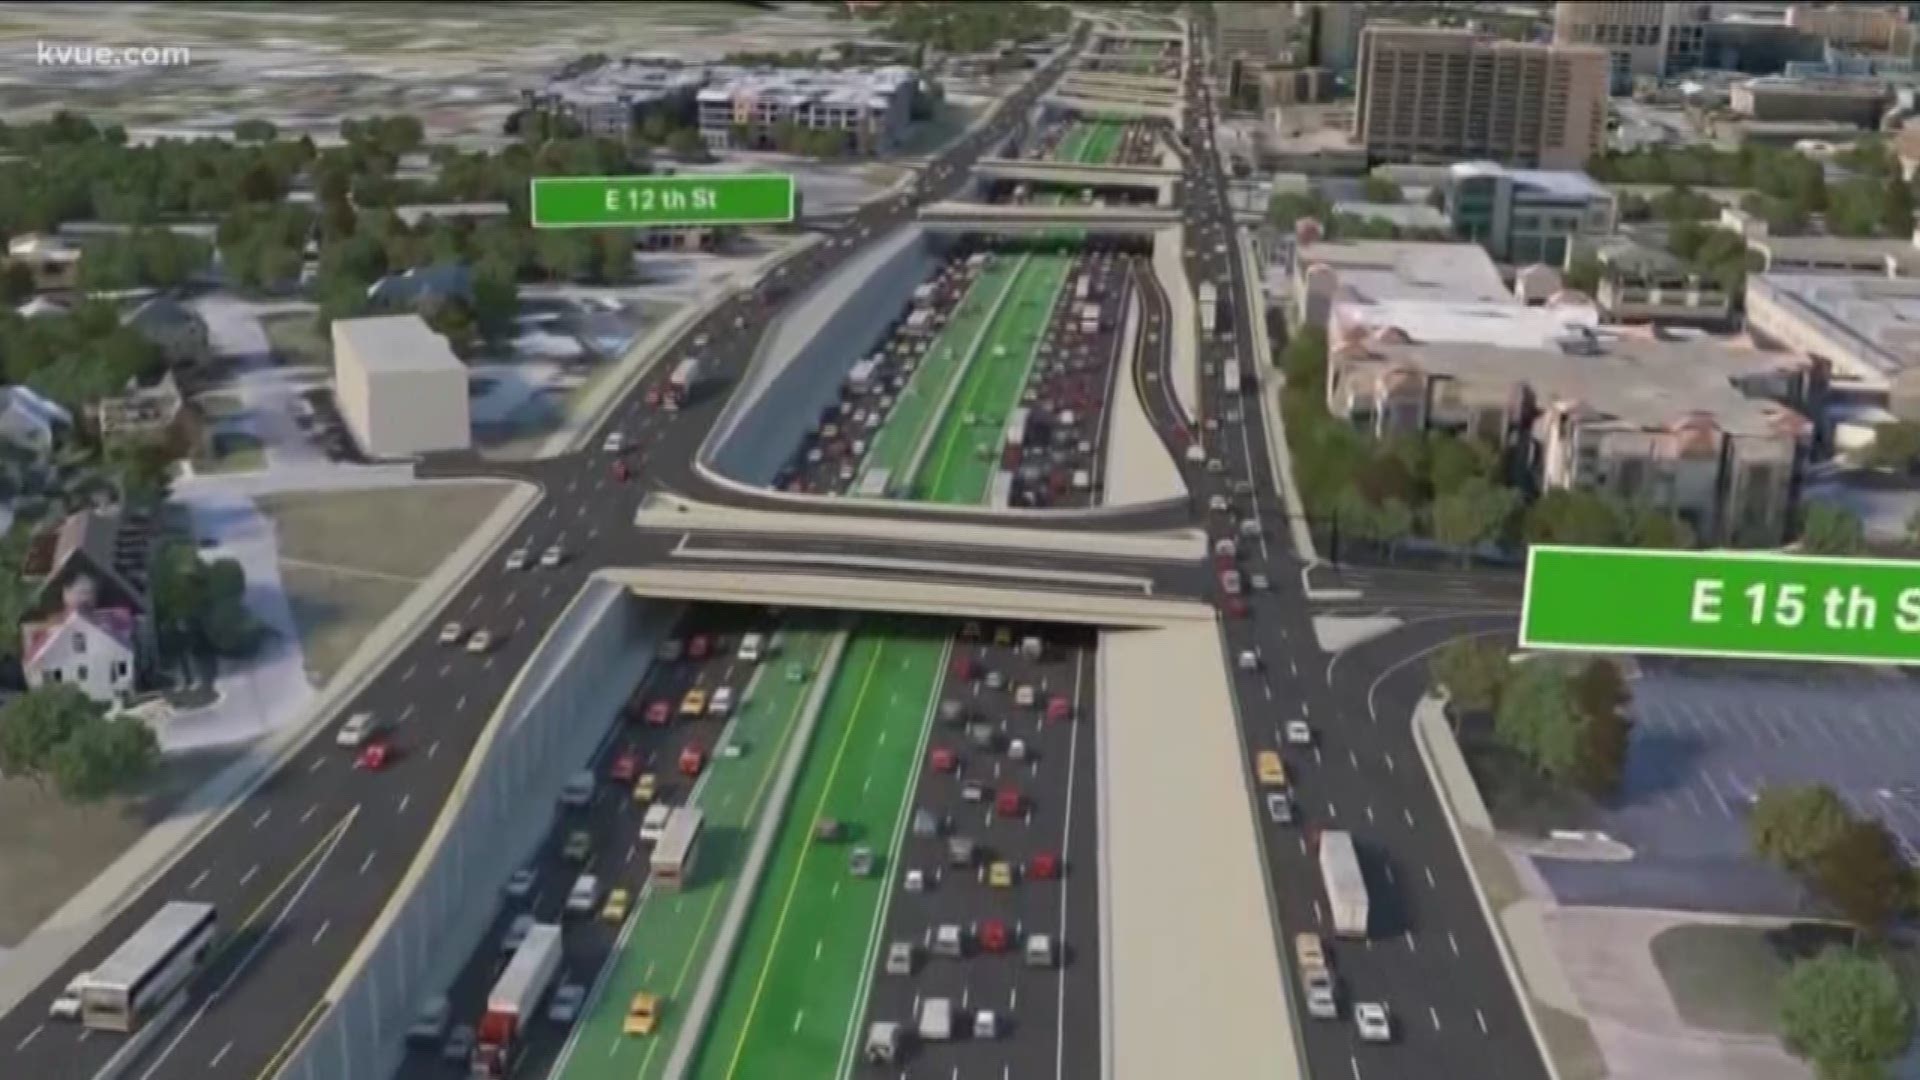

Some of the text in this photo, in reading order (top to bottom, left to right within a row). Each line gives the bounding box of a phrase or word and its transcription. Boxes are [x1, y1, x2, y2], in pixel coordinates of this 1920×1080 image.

[605, 188, 717, 211] E 12 th St
[1690, 578, 1724, 623] E
[1744, 582, 1807, 627] 15
[1822, 585, 1877, 630] th
